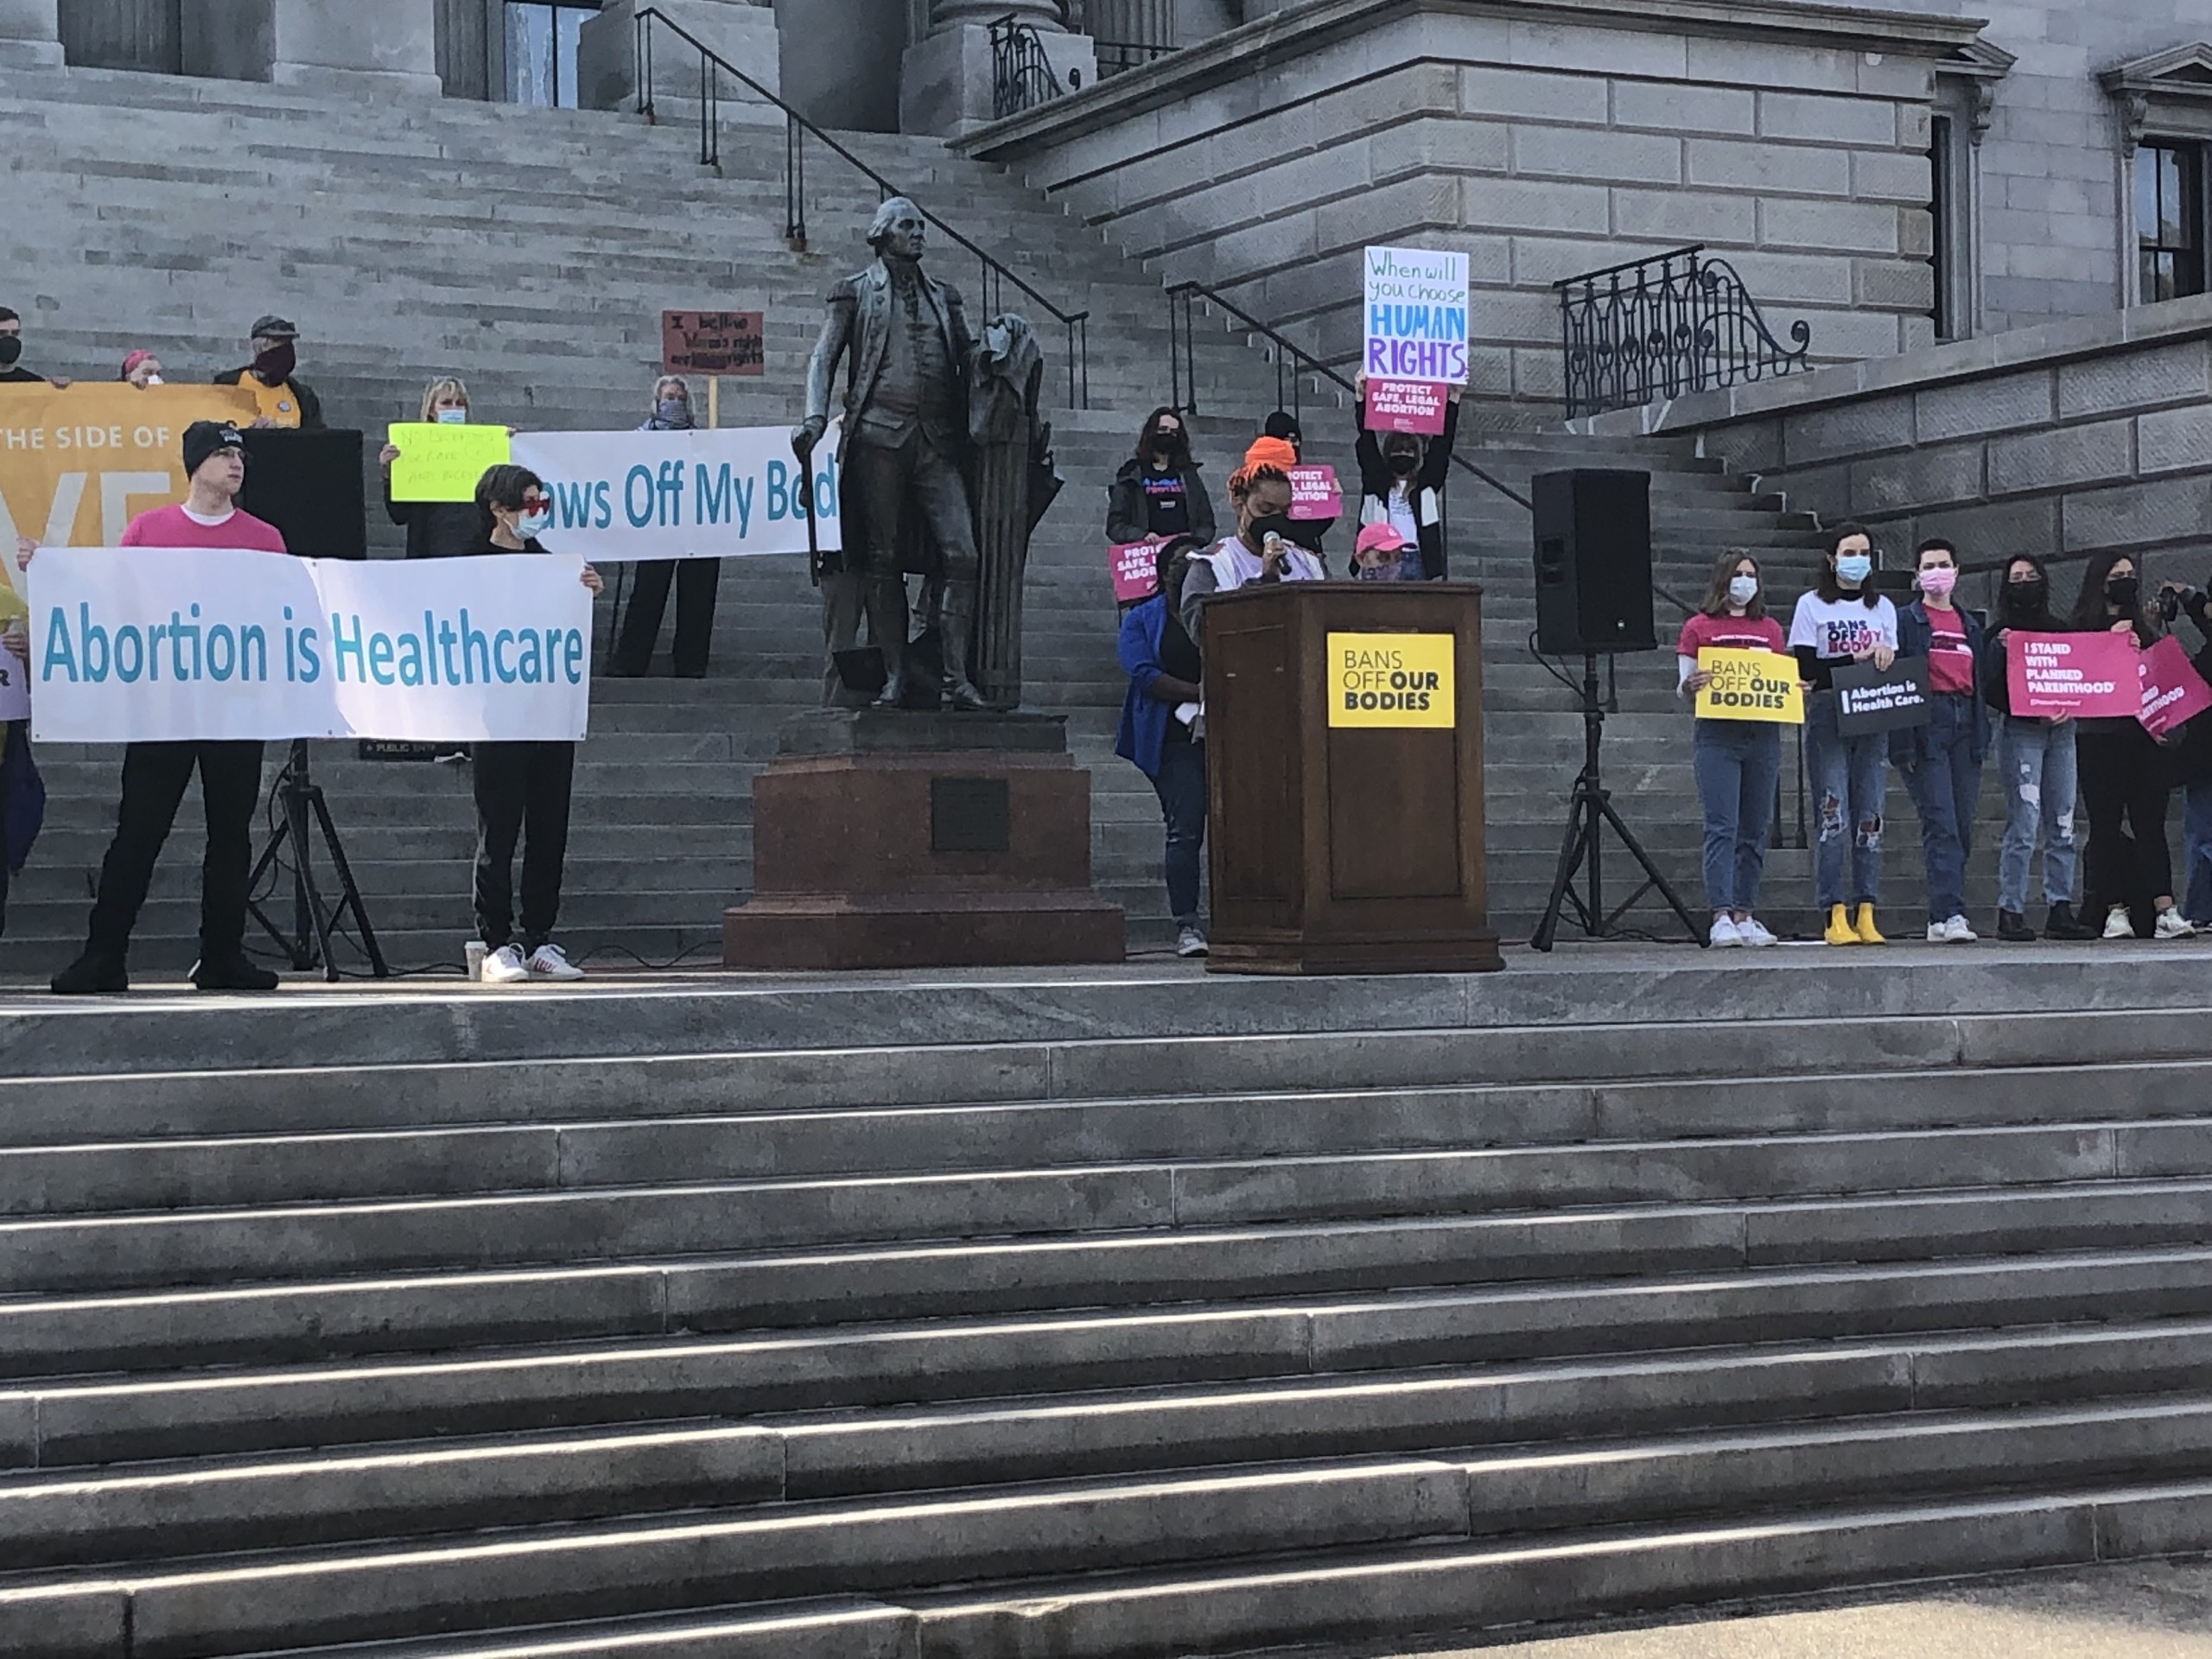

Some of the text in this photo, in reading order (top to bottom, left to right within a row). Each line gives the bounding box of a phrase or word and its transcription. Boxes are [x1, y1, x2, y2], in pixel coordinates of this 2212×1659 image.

[1368, 251, 1456, 281] When will
[1369, 281, 1404, 302] you
[1370, 304, 1465, 341] HUMAN
[1369, 338, 1466, 378] RIGHTS
[1382, 383, 1432, 395] PROTECT
[1372, 392, 1440, 406] SAFE, LEGAL
[1375, 404, 1434, 416] ABORTION
[0, 426, 170, 449] HE SIDE OF
[1300, 480, 1332, 491] LEGAL
[541, 452, 837, 539] aws Off My Bod
[1124, 566, 1157, 582] ABOR
[1827, 620, 1868, 631] BANS
[42, 601, 584, 687] Abortion is Healthcare
[1828, 630, 1857, 642] OFF
[2031, 643, 2071, 654] STAND
[1344, 650, 1403, 669] BANS
[1712, 660, 1762, 677] BANS
[2024, 656, 2057, 668] WITH
[1343, 671, 1440, 690] OFF OUR
[2026, 669, 2083, 681] PLANNED
[1710, 676, 1791, 696] OFF OUR
[1851, 680, 1917, 700] Abortion is
[2028, 682, 2115, 694] PARENTHOOD
[1344, 691, 1430, 711] BODIES
[1710, 691, 1785, 709] BODIES
[1852, 695, 1924, 713] Health Care.
